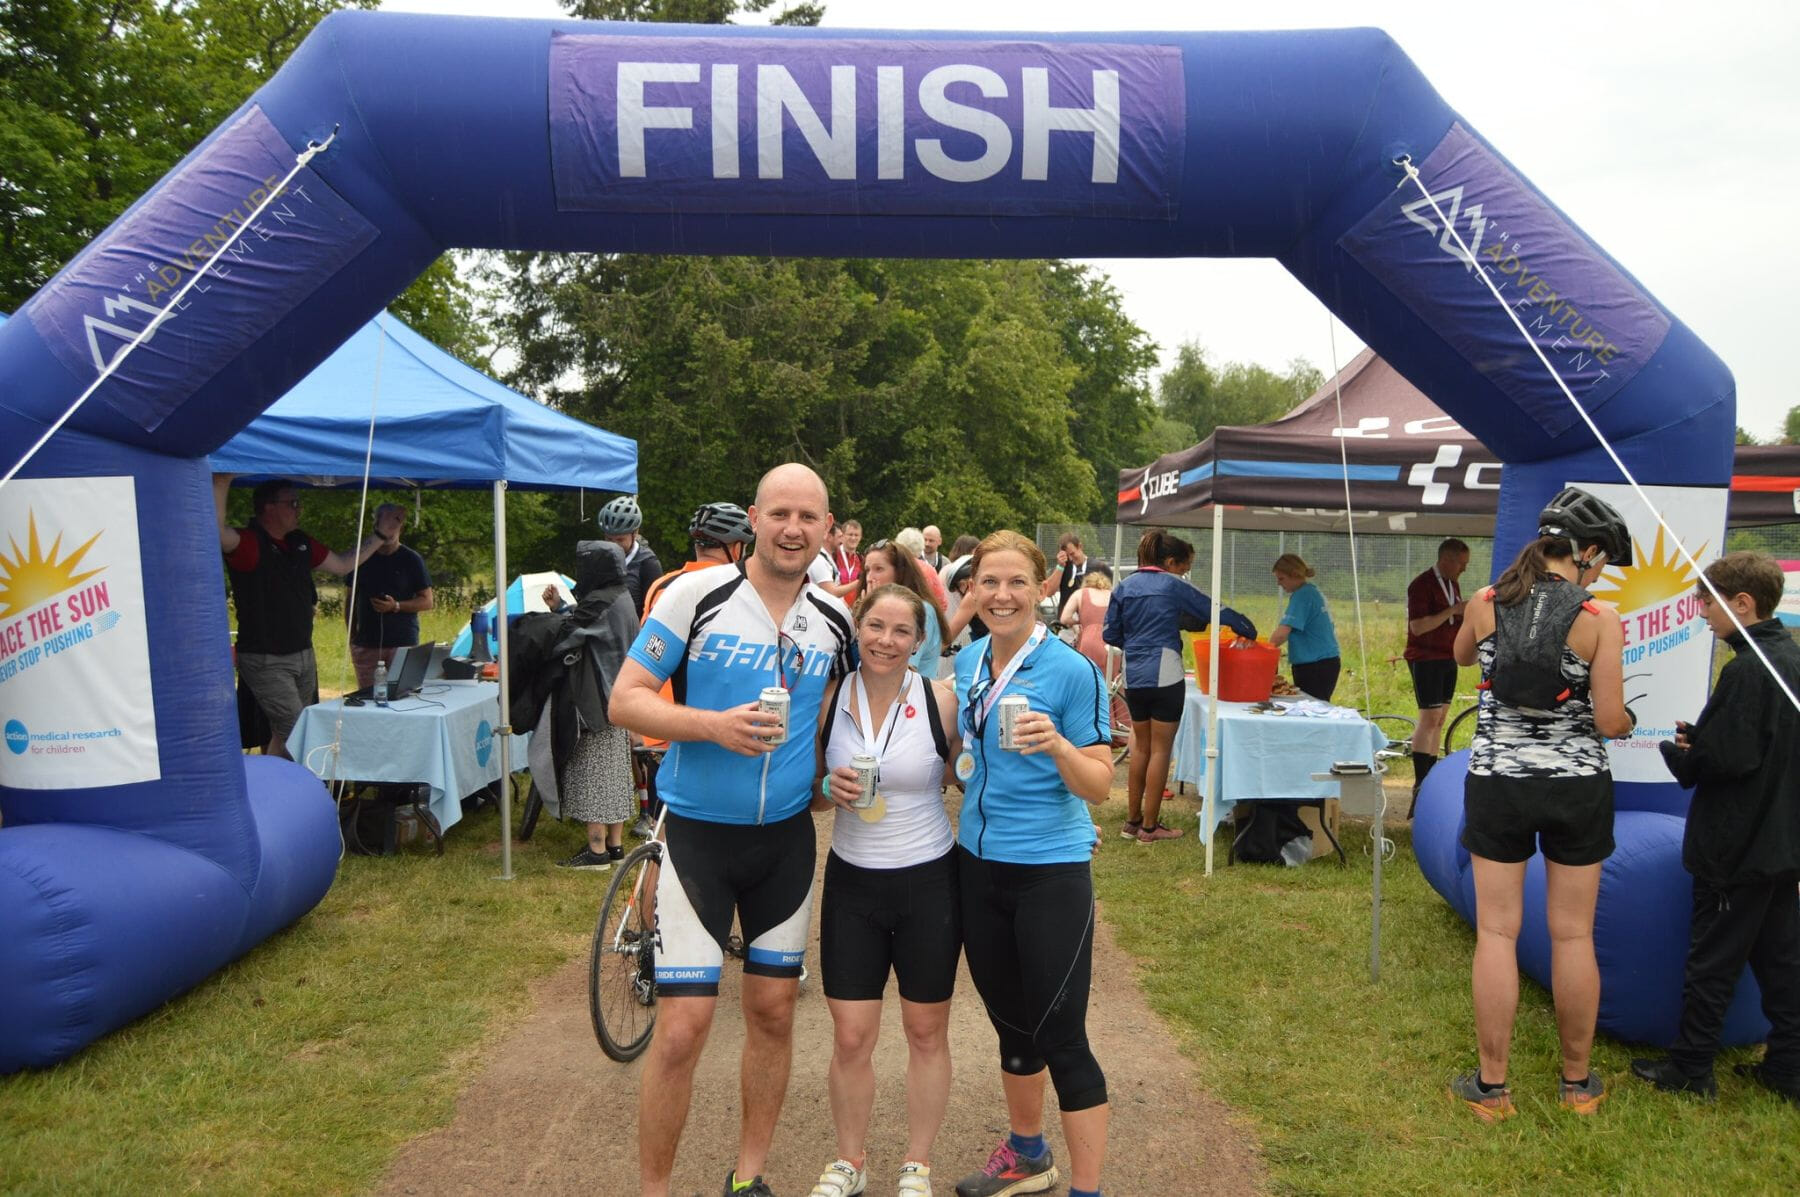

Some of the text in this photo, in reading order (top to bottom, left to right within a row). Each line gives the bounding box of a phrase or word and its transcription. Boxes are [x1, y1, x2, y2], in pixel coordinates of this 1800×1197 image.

[617, 62, 1120, 183] FINISH
[146, 174, 290, 302] ADVENTURE
[170, 185, 313, 312] ELEMENT
[1489, 221, 1521, 253] THE
[121, 261, 158, 293] THE
[1482, 243, 1621, 366] ADVENTURE
[1474, 264, 1610, 385] ELEMENT
[1149, 470, 1179, 499] CUBE
[0, 581, 110, 660] ACE THE SUN
[1637, 605, 1670, 640] THE
[0, 622, 93, 684] EVER STOP PUSHING
[691, 632, 832, 677] Santin
[1648, 626, 1690, 657] PUSHING
[31, 728, 122, 741] medical research
[32, 745, 85, 754] for children
[1614, 740, 1660, 749] for childre
[1633, 727, 1675, 737] dical rese
